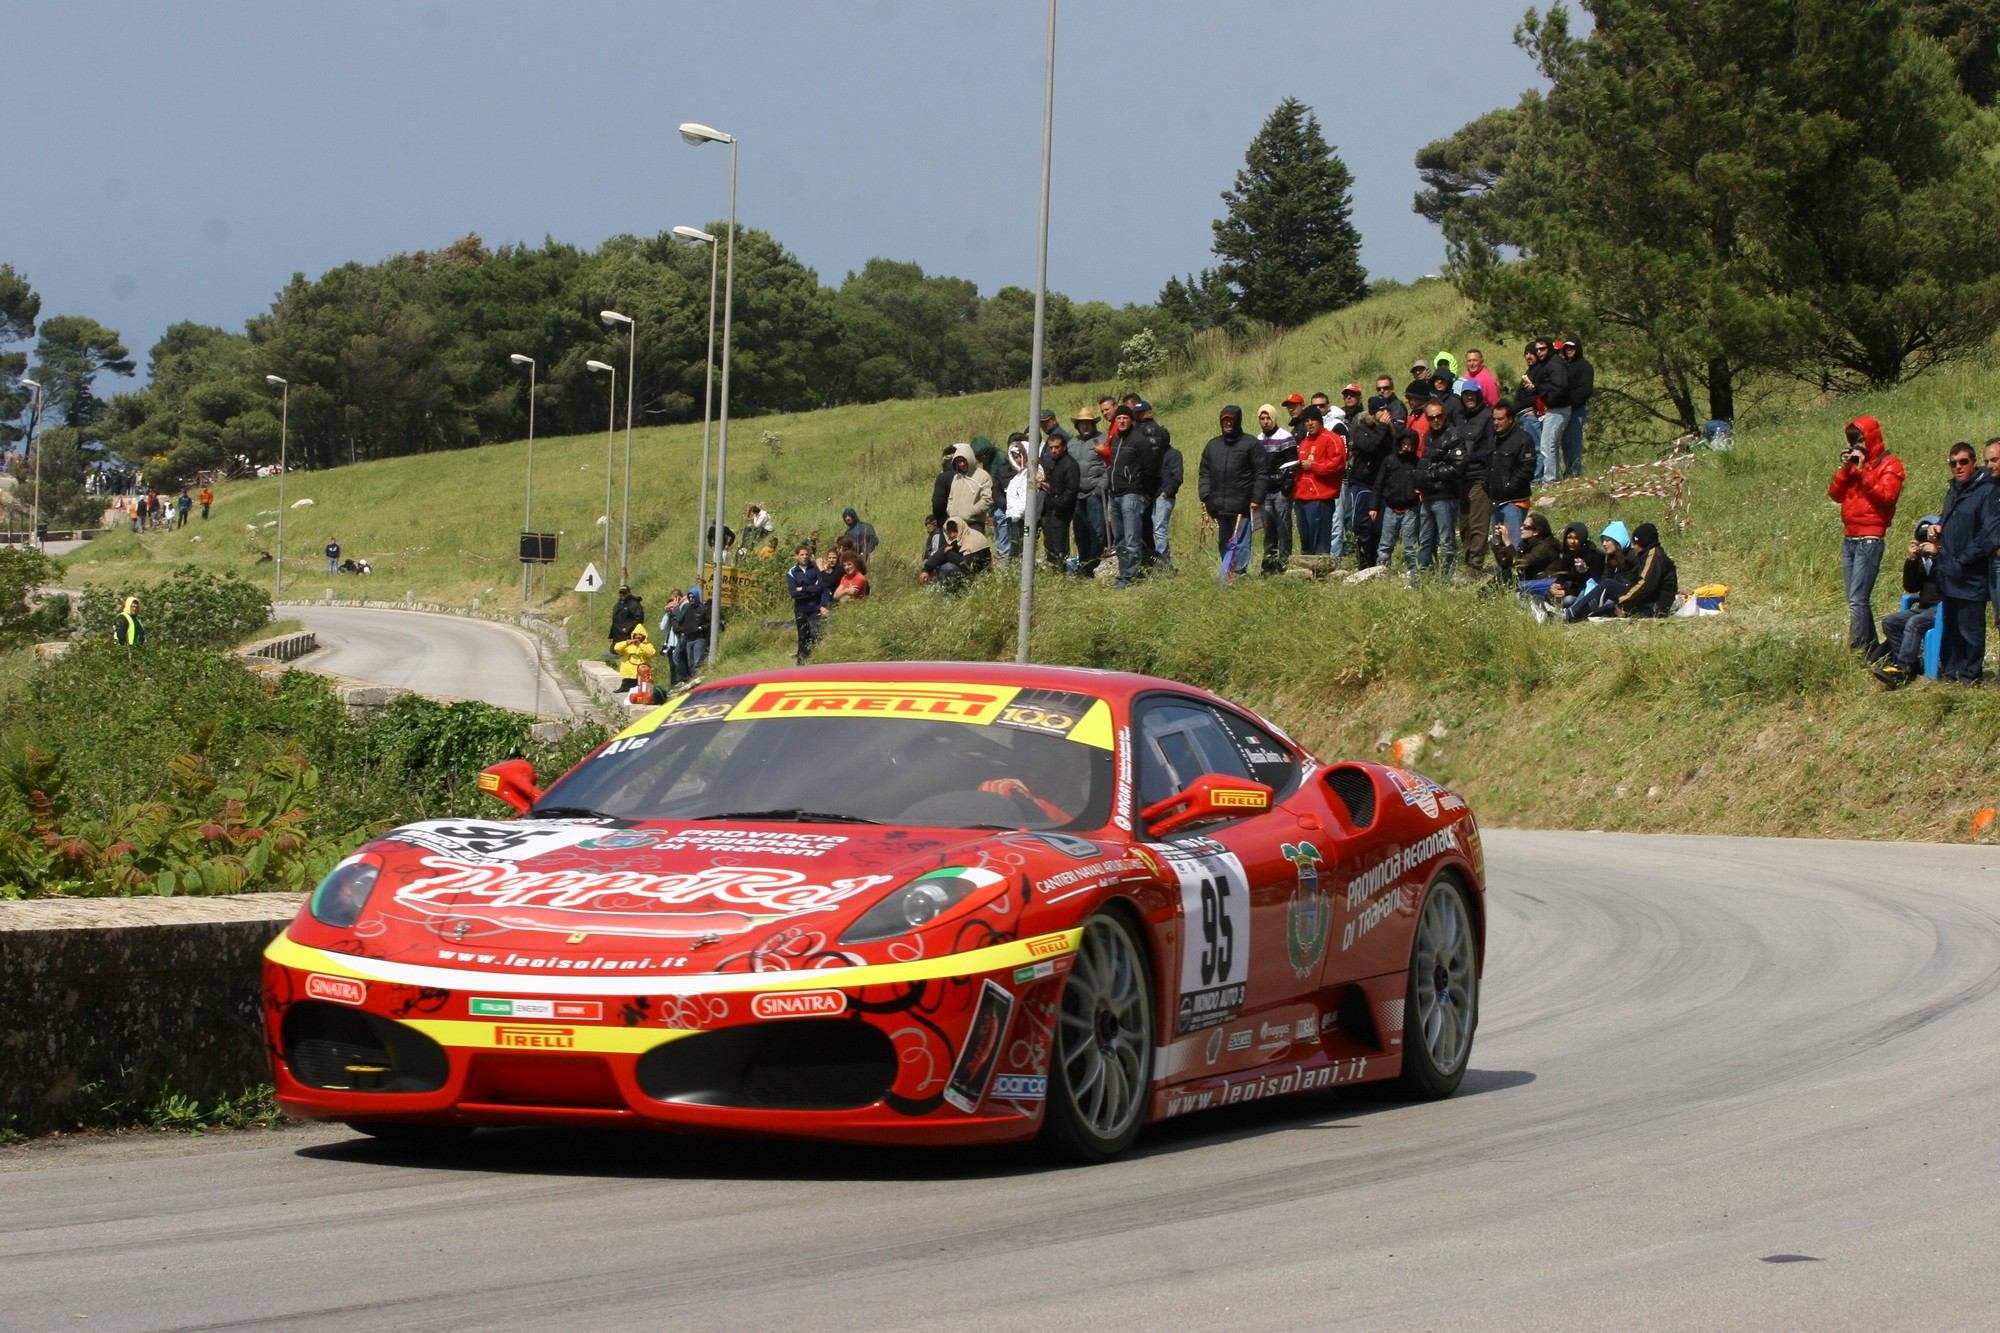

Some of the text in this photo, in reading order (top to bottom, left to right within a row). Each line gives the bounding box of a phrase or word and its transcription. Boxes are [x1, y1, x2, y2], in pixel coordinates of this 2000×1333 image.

[745, 688, 998, 717] PIRELLI
[1002, 708, 1074, 729] 100
[1214, 791, 1265, 806] PIRELLI
[1201, 875, 1233, 986] 95
[1342, 919, 1355, 952] DI
[1025, 933, 1070, 956] PIRELLI
[438, 950, 689, 970] www.leoisolani.it
[311, 979, 359, 999] SINATRA
[1238, 985, 1246, 1004] 3
[516, 1004, 550, 1014] ENERGY
[558, 1005, 585, 1015] DRINK
[762, 996, 837, 1014] SINATRA
[495, 1025, 575, 1048] PIRELLI
